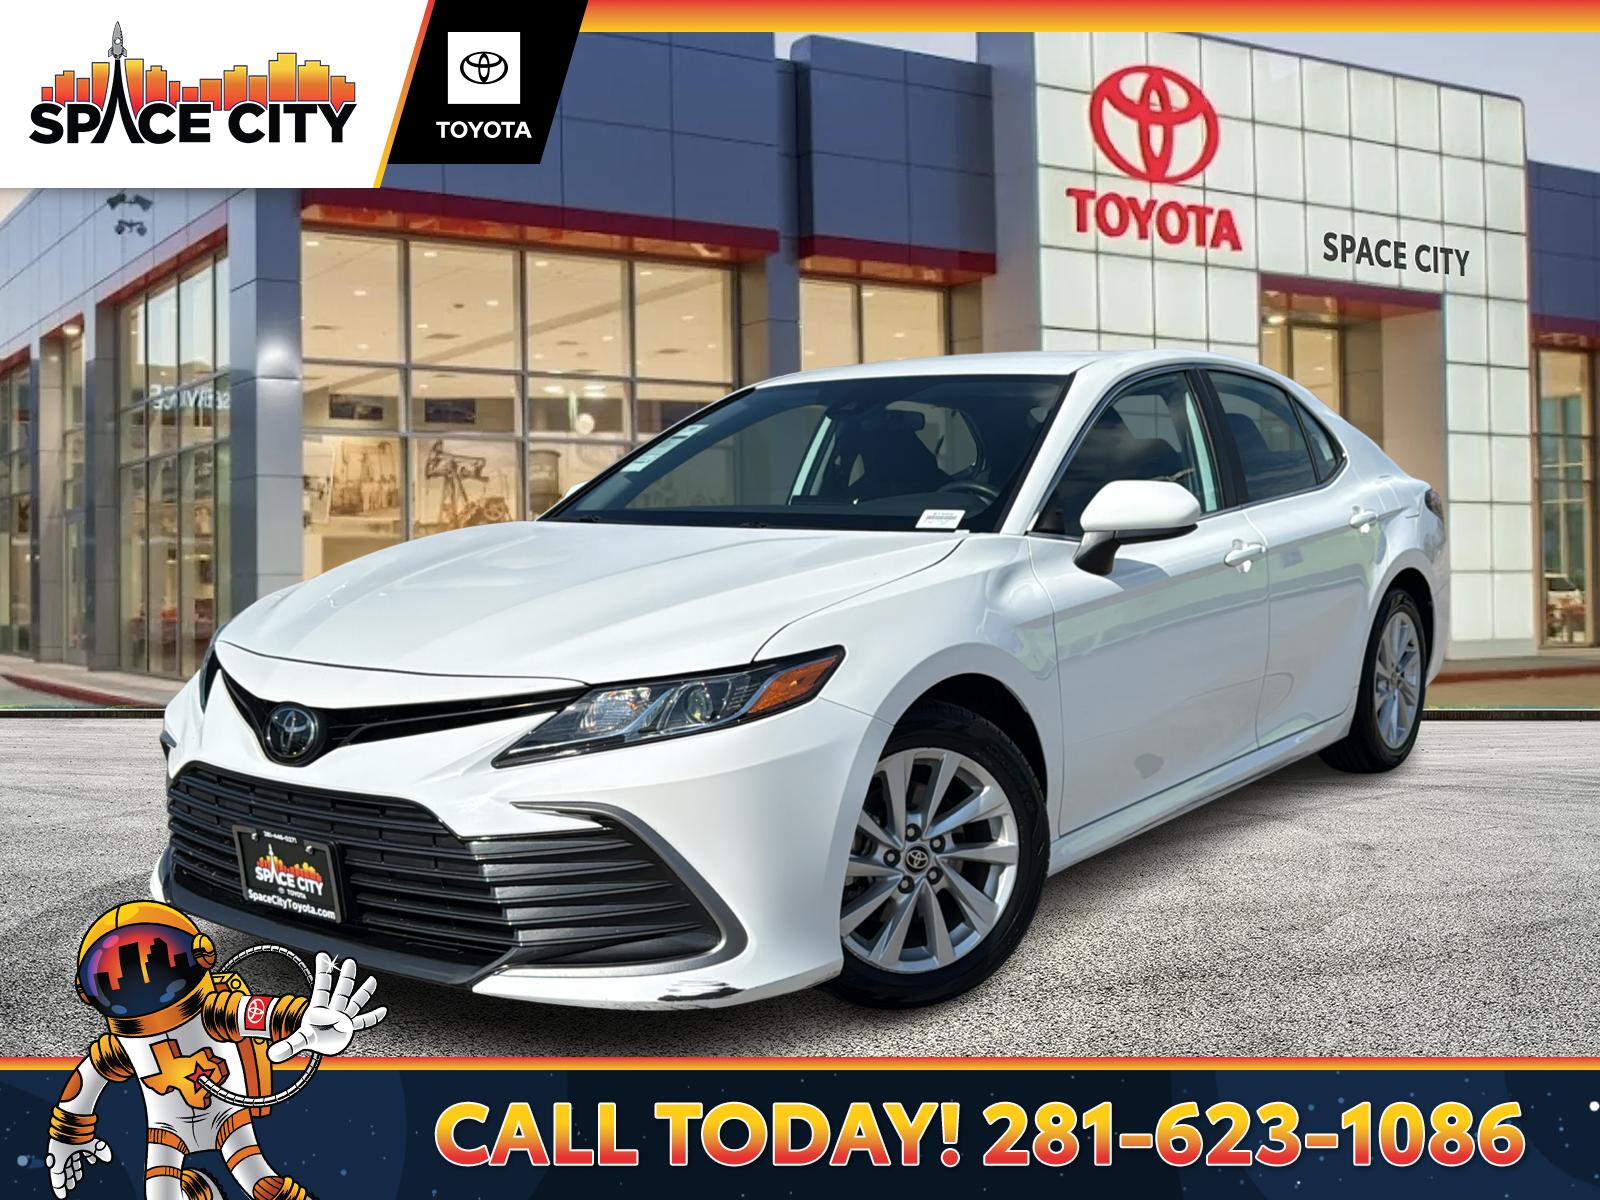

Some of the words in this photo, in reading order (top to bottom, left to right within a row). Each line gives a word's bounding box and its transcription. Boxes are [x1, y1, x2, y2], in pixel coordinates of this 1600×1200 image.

[1066, 187, 1243, 251] TOYOTA
[1323, 231, 1407, 270] SPACE
[1414, 244, 1470, 276] CITY
[255, 859, 296, 889] SPACE
[296, 876, 323, 896] CITY
[286, 888, 307, 900] TOYOTA
[247, 888, 336, 919] SpaceCityToyota.com
